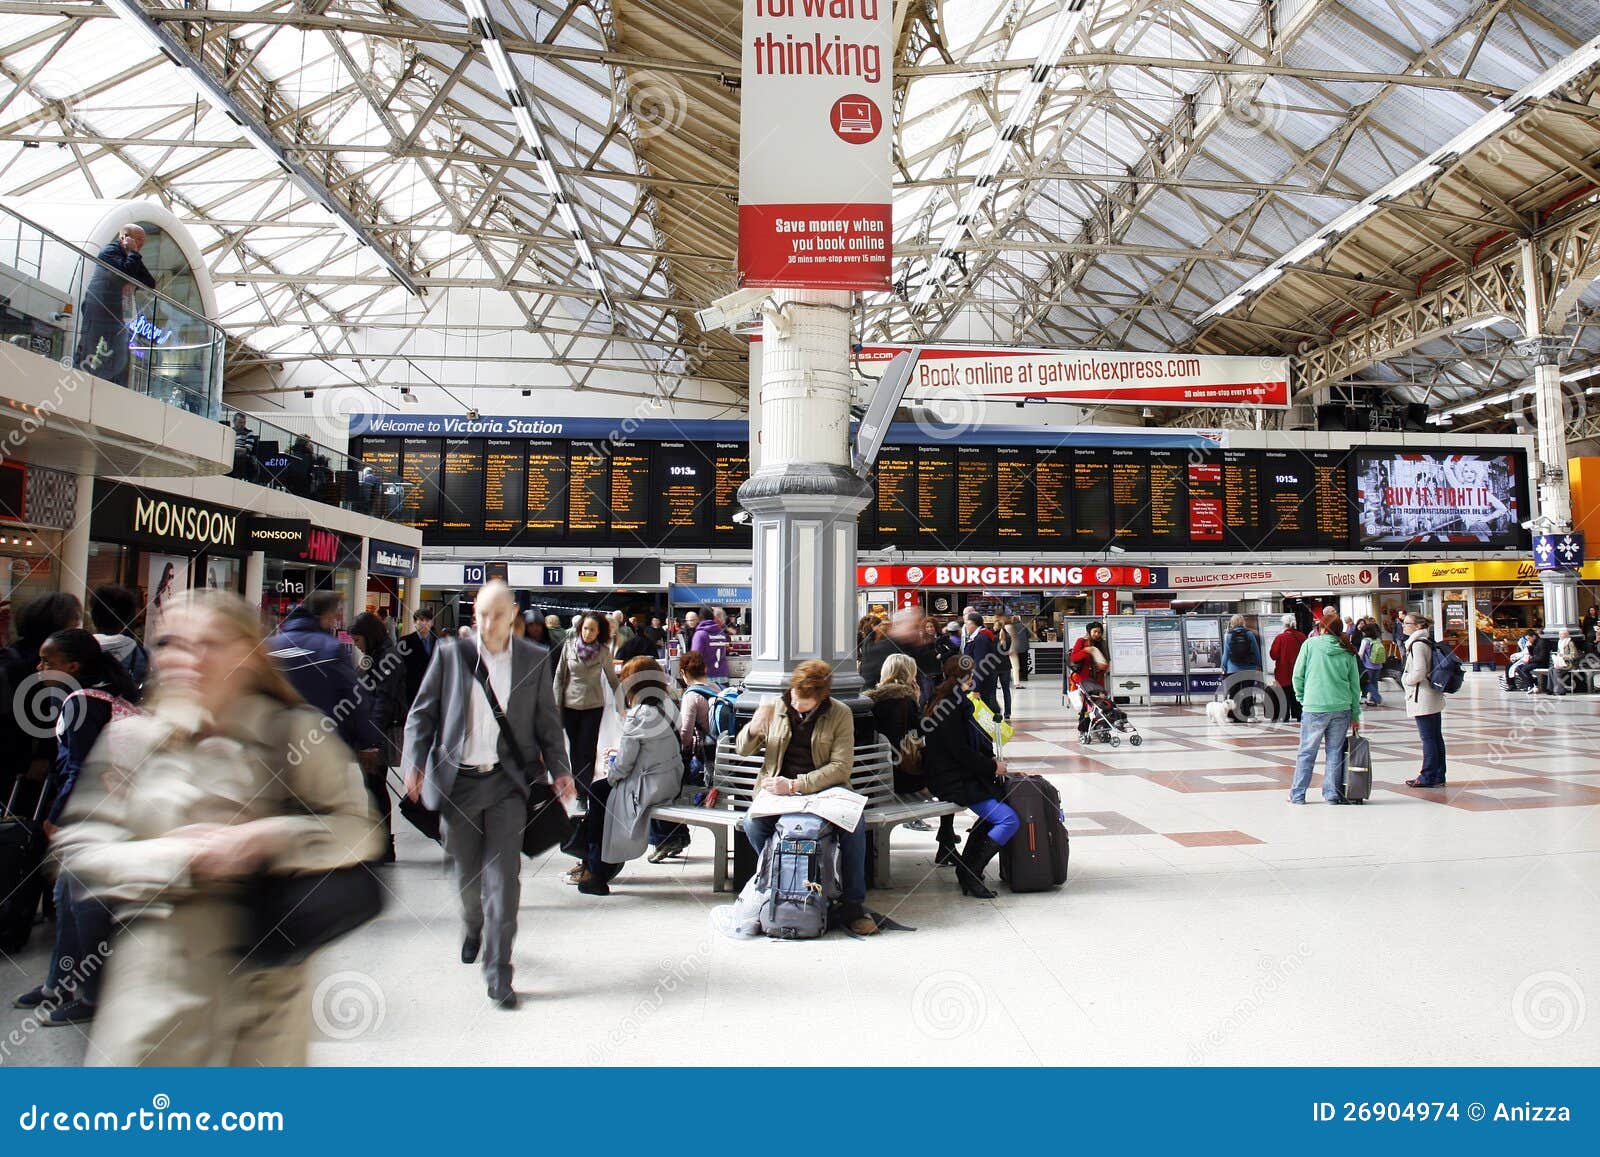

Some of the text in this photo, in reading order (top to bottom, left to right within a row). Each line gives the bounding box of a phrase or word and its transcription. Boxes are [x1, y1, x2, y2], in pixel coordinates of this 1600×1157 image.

[754, 33, 880, 83] thinking
[775, 218, 884, 234] Save money when
[792, 236, 885, 253] you book online
[788, 256, 797, 264] 30
[798, 255, 813, 263] mins
[815, 255, 842, 264] non-stop
[844, 255, 861, 263] every
[870, 254, 885, 262] mins
[919, 358, 1201, 387] Book online at gatwickexpress.com
[370, 419, 563, 434] Welcome to Victoria Station
[1385, 487, 1412, 507] BUY
[1435, 487, 1472, 507] FIGHT
[135, 497, 236, 546] MONSOON
[251, 530, 302, 540] MONSOON
[466, 568, 481, 581] 10
[548, 570, 559, 582] 11
[936, 567, 1025, 585] BURGER
[1029, 567, 1083, 585] KING
[1326, 573, 1355, 587] Tickets
[1388, 573, 1400, 583] 14
